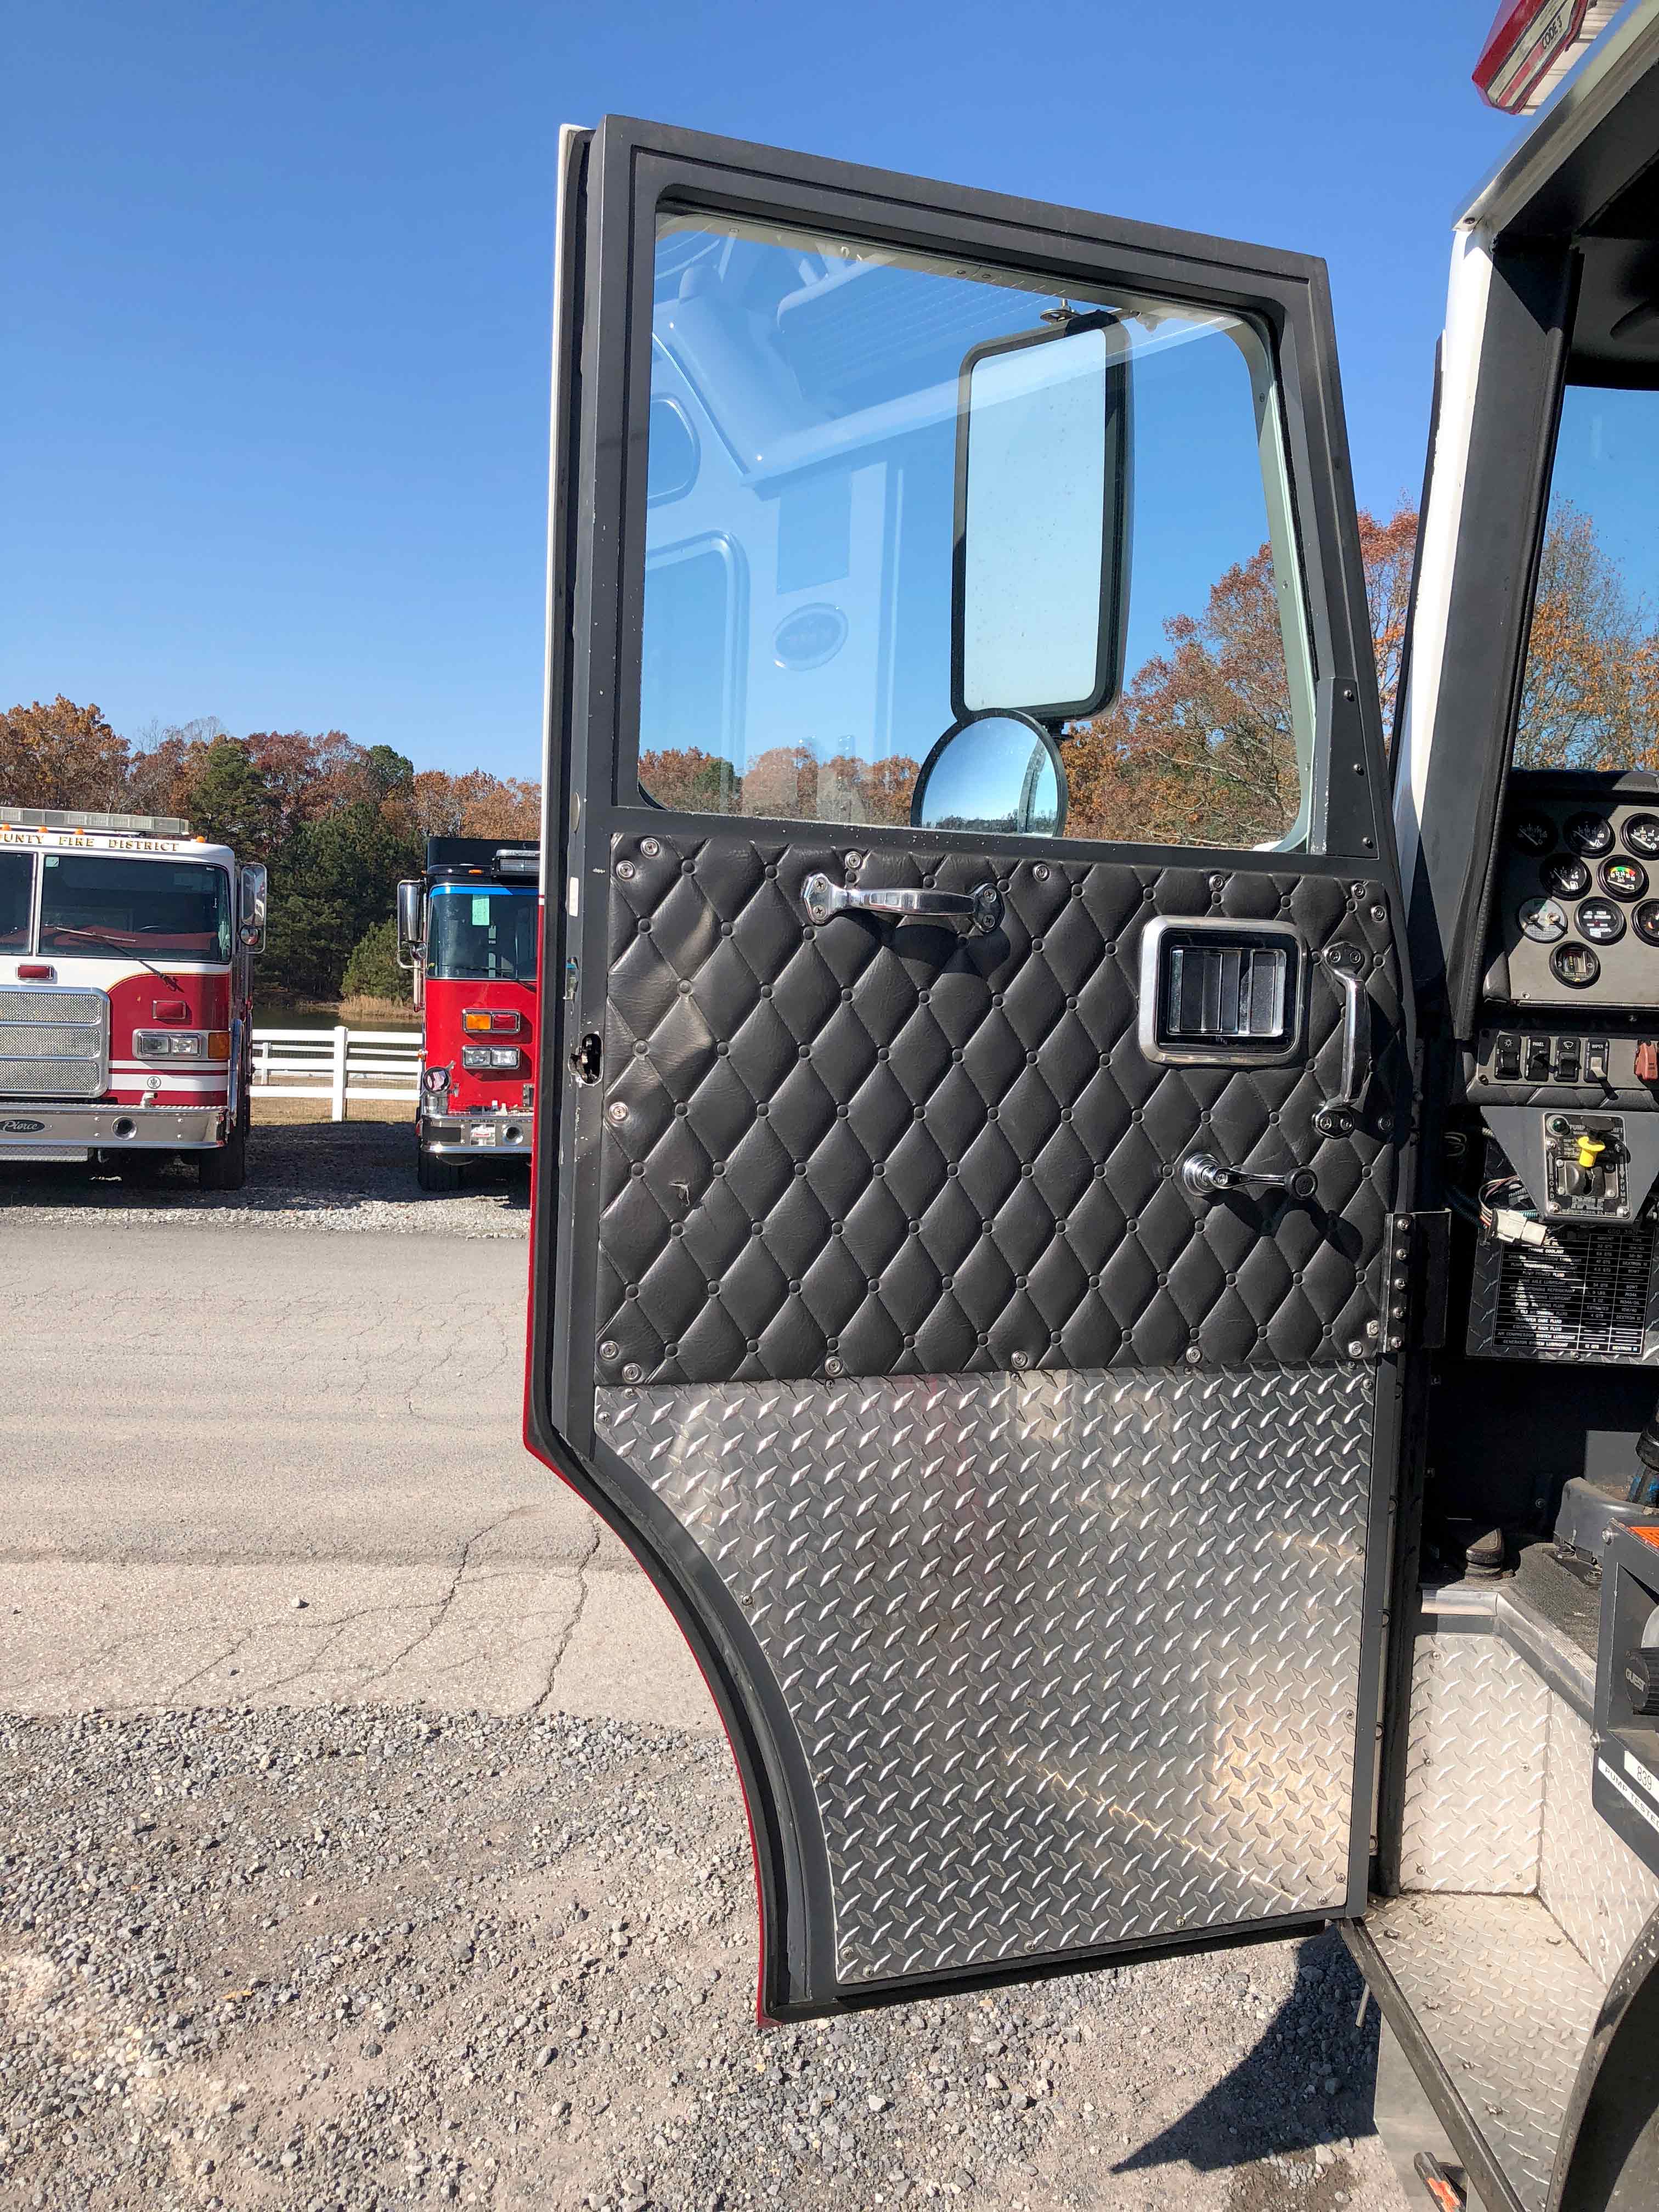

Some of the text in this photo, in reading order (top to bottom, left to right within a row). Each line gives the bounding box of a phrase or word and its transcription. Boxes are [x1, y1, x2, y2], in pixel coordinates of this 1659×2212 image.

[1542, 21, 1558, 50] CODE
[1557, 15, 1562, 27] 3
[59, 836, 95, 847] FIRE
[109, 839, 179, 851] DISTRICT
[2, 1120, 38, 1131] Pierce
[1605, 1767, 1628, 1791] PUMP
[1637, 1765, 1652, 1791] 839
